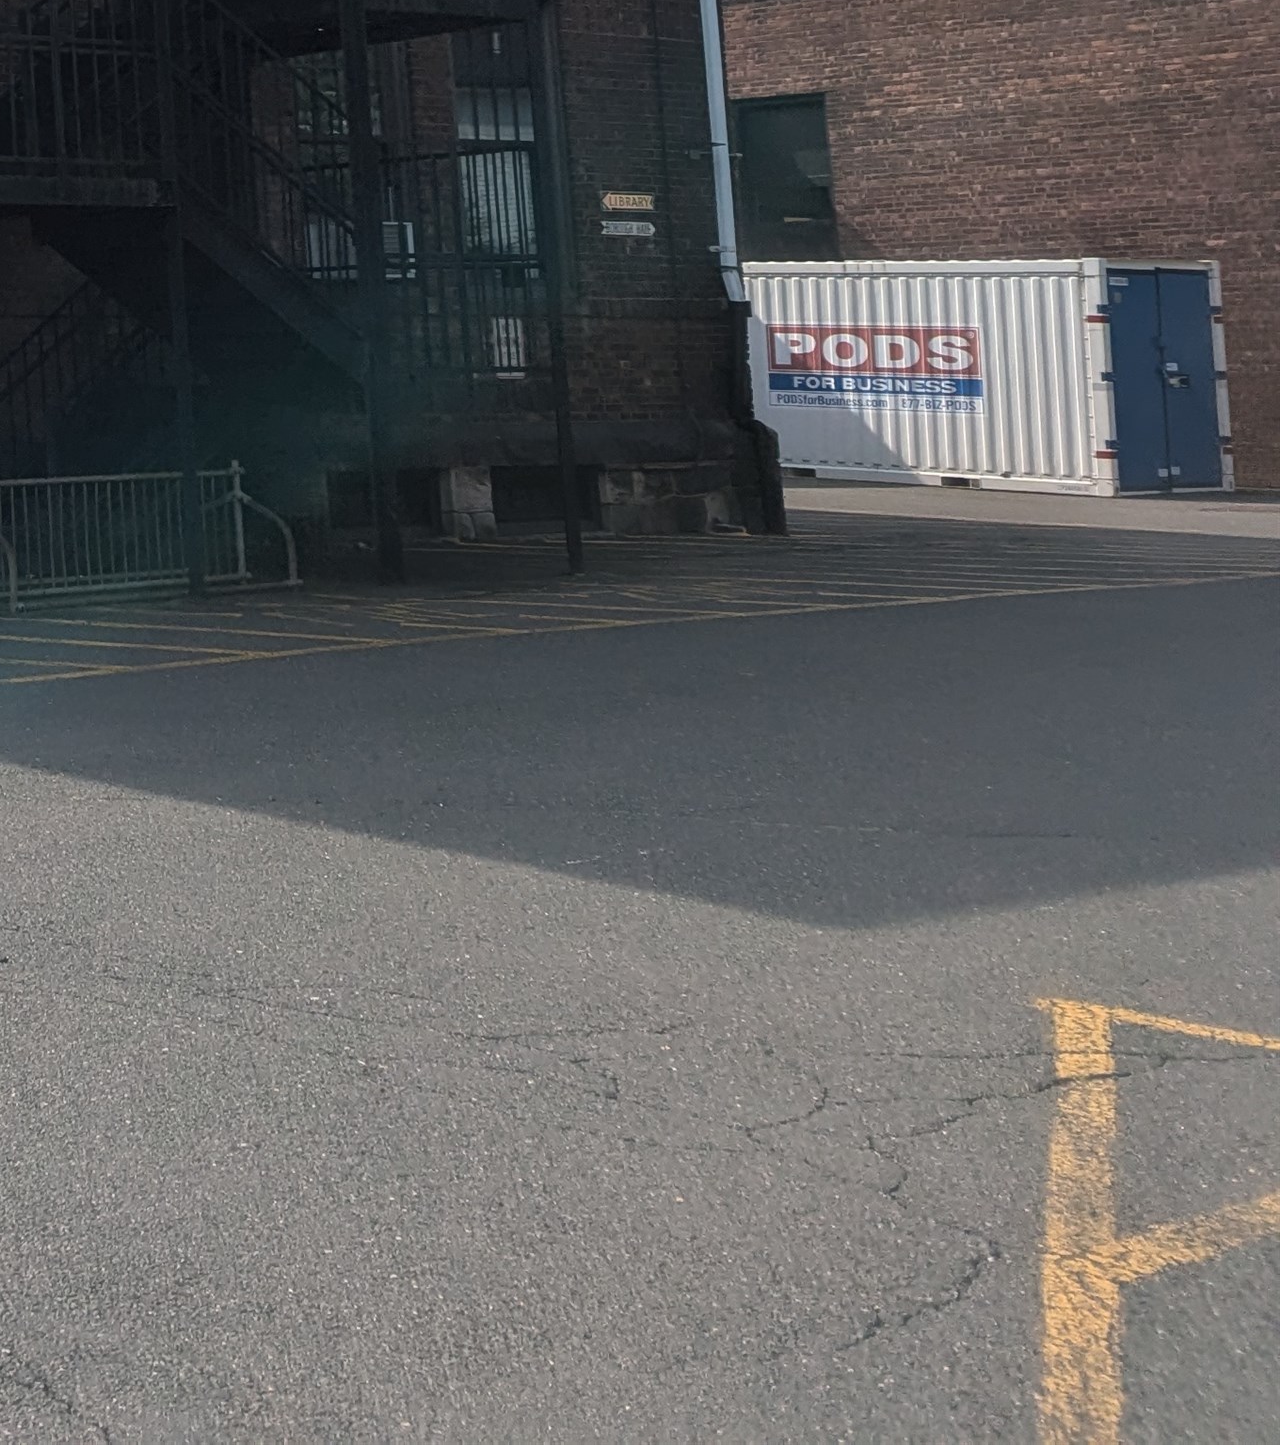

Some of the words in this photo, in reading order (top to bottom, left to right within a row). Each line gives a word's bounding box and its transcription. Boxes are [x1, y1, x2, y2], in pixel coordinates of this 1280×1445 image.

[608, 195, 650, 208] LIBRARY
[773, 332, 974, 371] PODS
[793, 376, 836, 391] FOR
[842, 377, 957, 394] BUSINESS
[776, 393, 889, 408] PODSforBusiness.com
